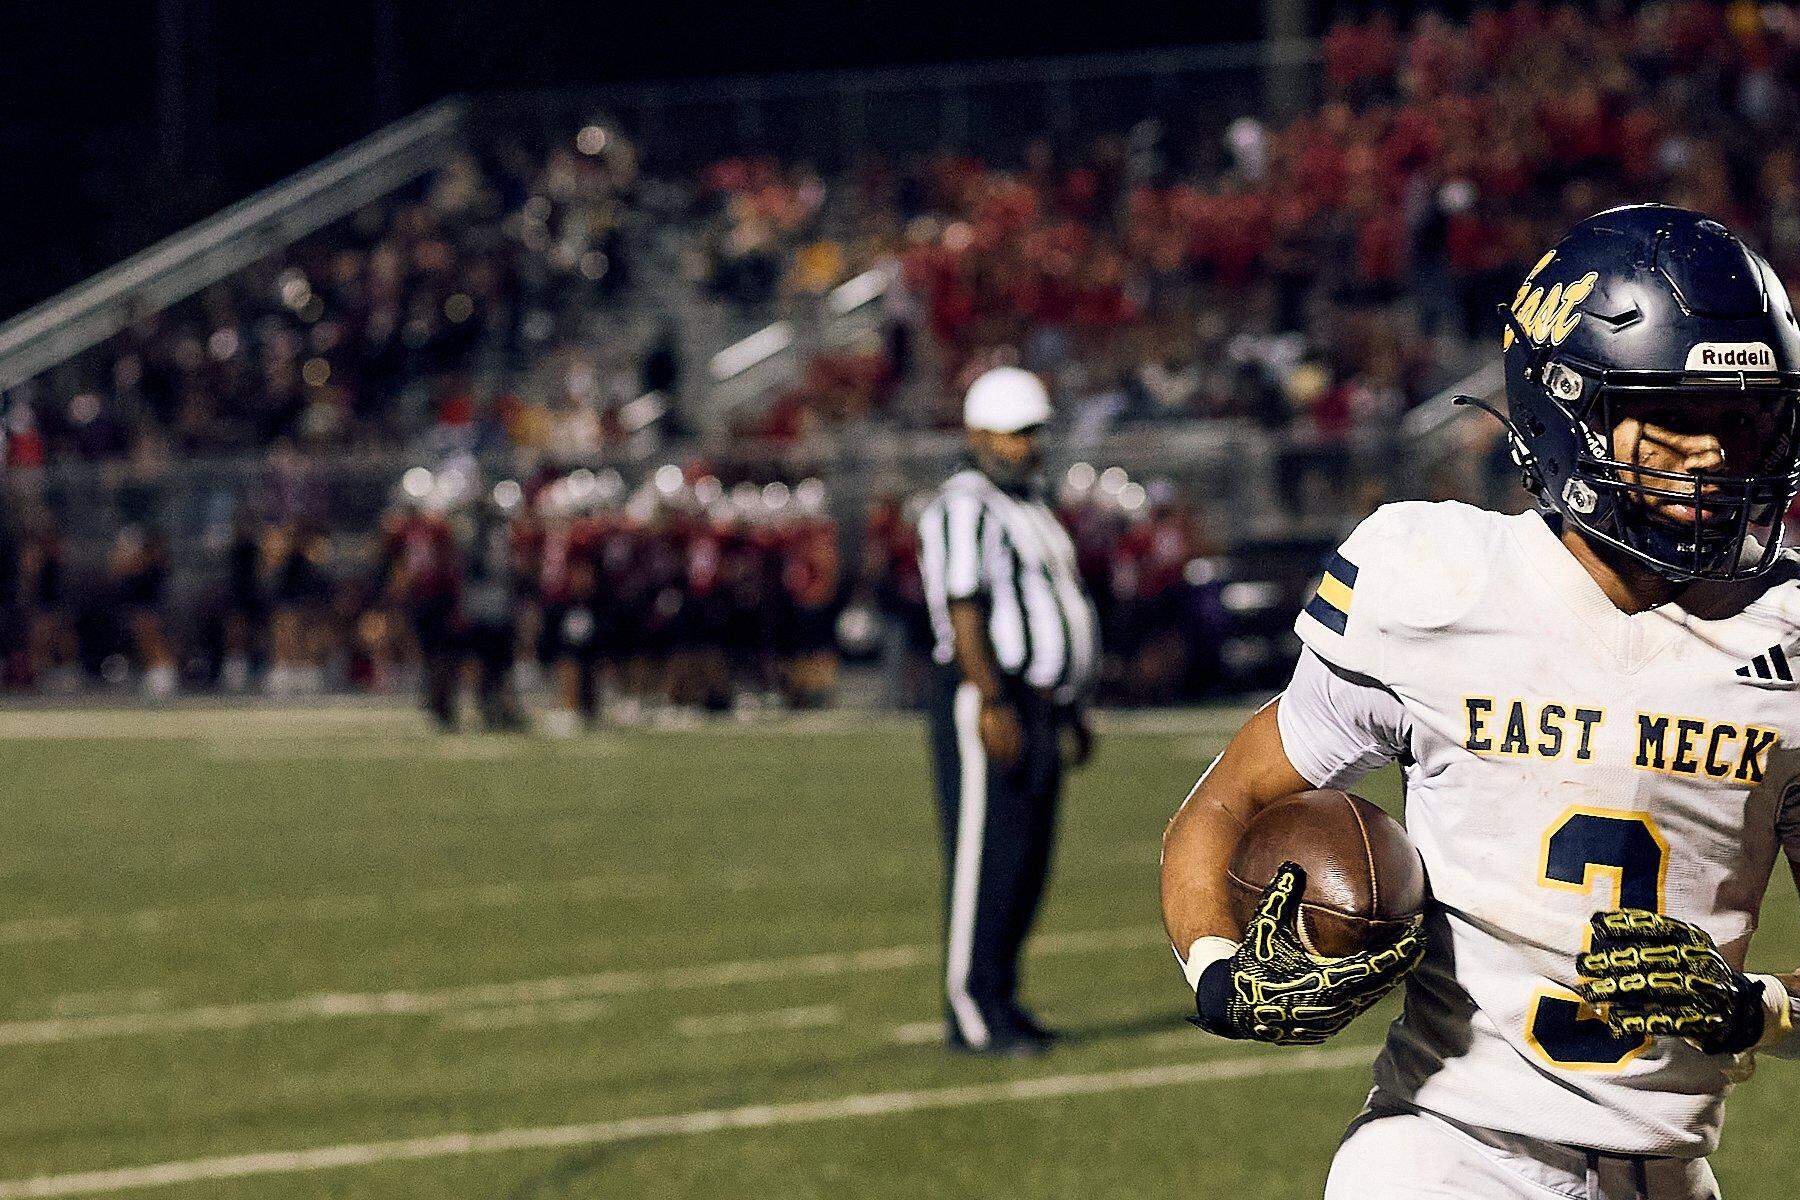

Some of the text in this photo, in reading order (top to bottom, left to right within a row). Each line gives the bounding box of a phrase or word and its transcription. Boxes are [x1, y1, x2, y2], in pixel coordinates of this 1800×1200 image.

[1702, 349, 1770, 366] Riddell
[1462, 695, 1779, 785] EAST MECK
[1527, 806, 1668, 1071] 3
